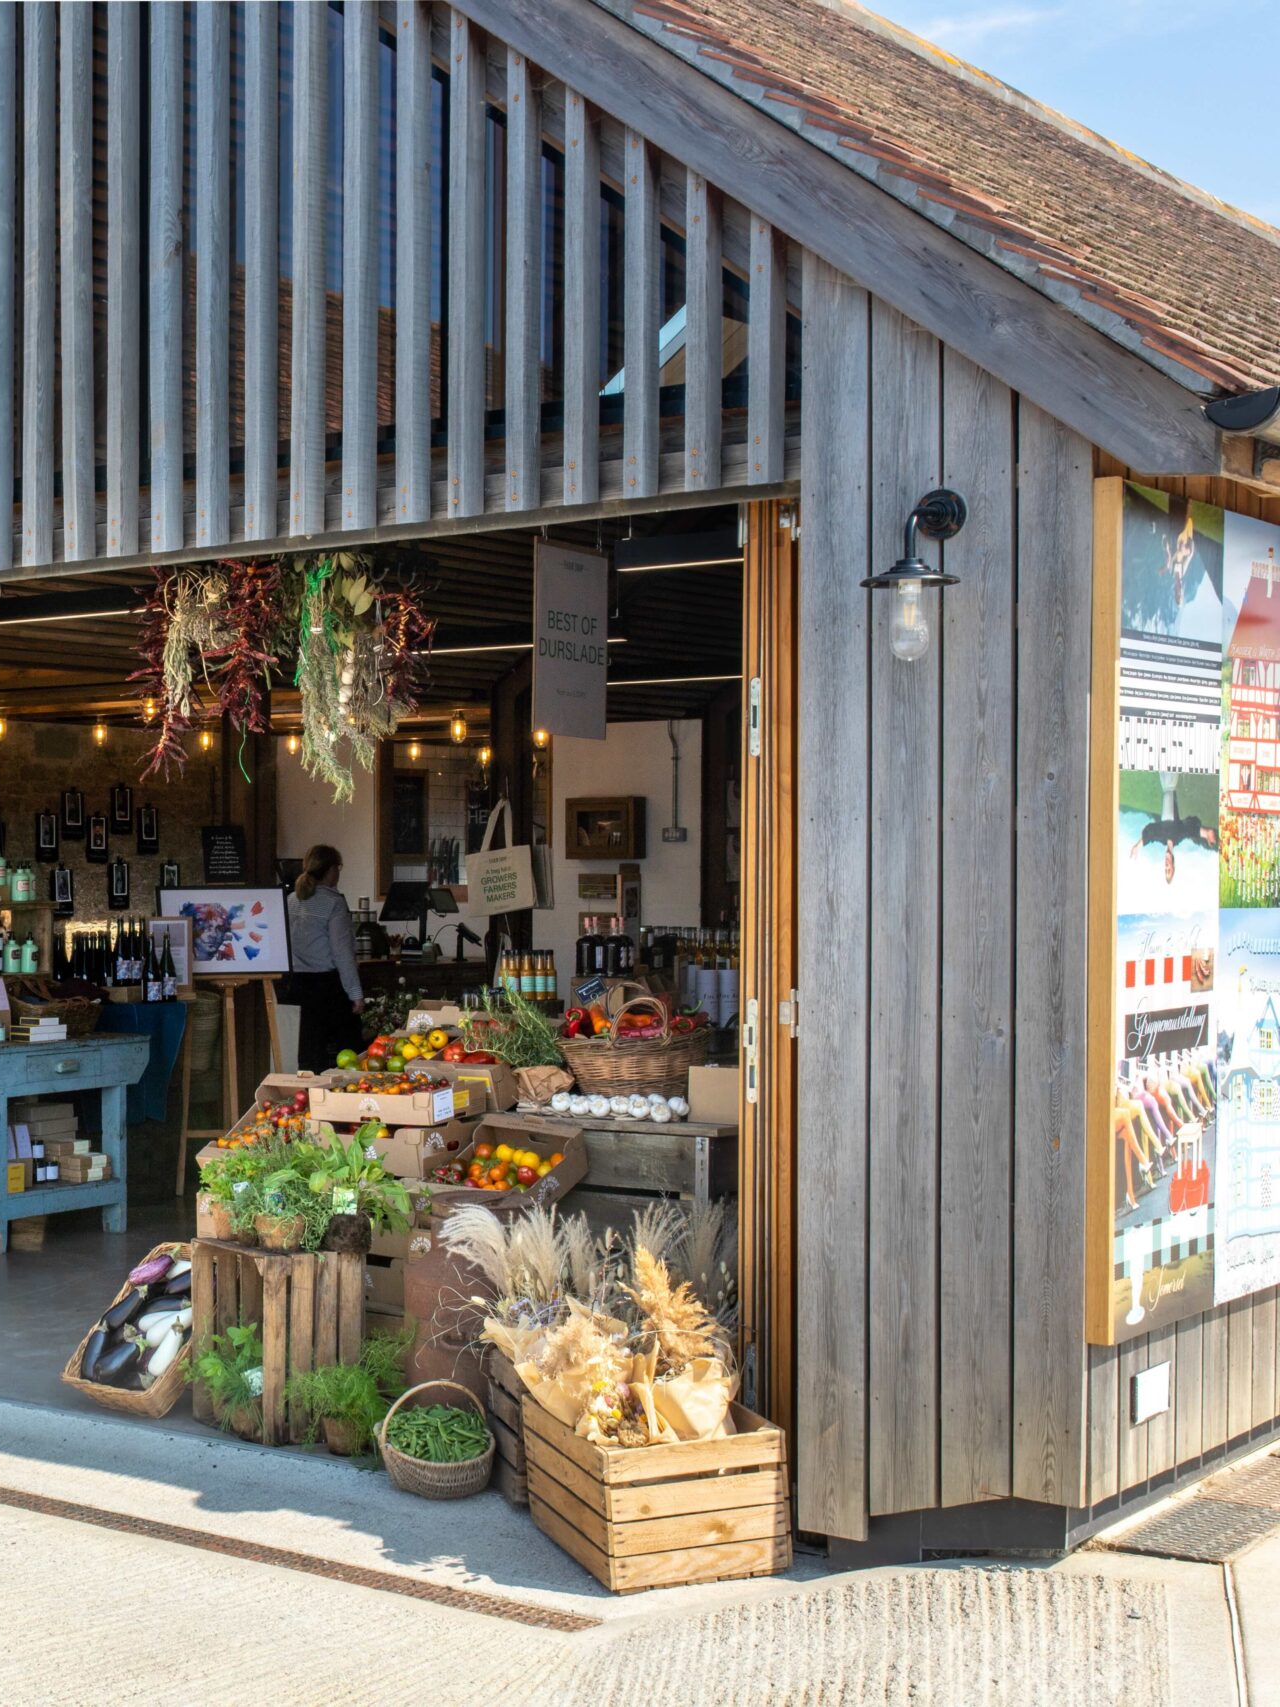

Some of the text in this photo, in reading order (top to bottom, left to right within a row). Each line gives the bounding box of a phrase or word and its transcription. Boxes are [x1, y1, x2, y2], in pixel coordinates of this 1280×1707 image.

[547, 610, 598, 636] BEST OF
[539, 637, 605, 666] DURSLADE
[480, 872, 518, 885] GROWERS
[483, 881, 517, 894] FARMERS
[486, 891, 516, 903] MAKERS
